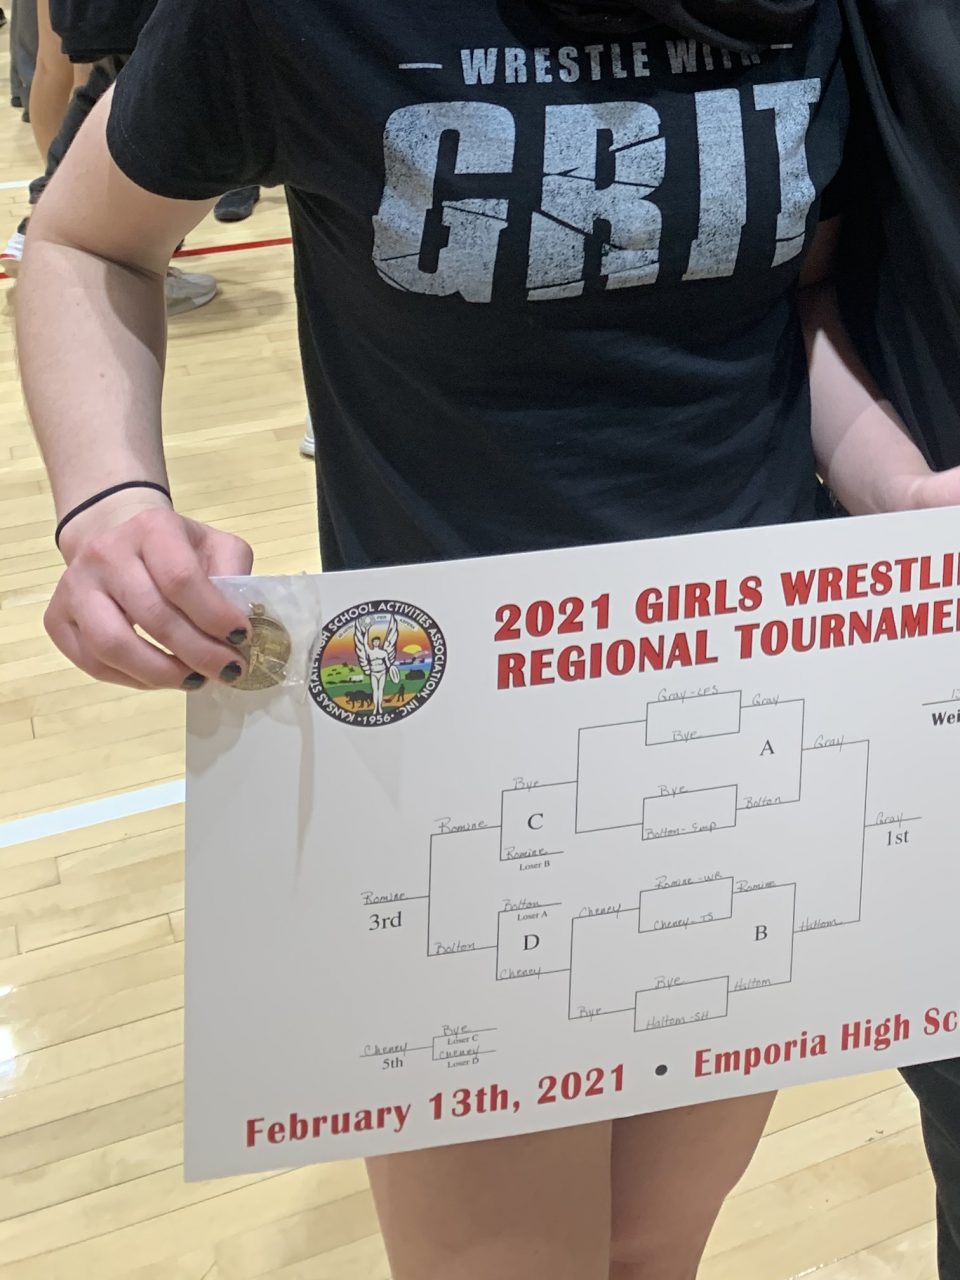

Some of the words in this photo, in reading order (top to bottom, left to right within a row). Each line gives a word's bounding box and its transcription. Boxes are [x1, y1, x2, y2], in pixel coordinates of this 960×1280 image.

[460, 40, 651, 85] WRESTLE
[372, 77, 822, 303] GRIT
[328, 603, 375, 632] SCHOOL
[378, 602, 433, 628] ACTIVITIES
[494, 593, 609, 642] 2021
[635, 575, 762, 625] GIRLS
[497, 629, 718, 690] REGIONAL
[316, 693, 356, 723] KANSAS
[363, 713, 391, 725] 1956
[759, 740, 775, 756] A
[527, 813, 543, 830] C
[887, 830, 909, 846] 1st
[520, 861, 541, 871] Loser
[544, 860, 550, 868] B
[369, 911, 402, 931] 3rd
[517, 913, 538, 921] Loser
[523, 934, 540, 951] D
[754, 925, 768, 942] B
[382, 1057, 404, 1070] 5th
[245, 1097, 413, 1149] February
[427, 1083, 521, 1122] 13th,
[536, 1061, 626, 1107] 2021
[694, 1031, 828, 1081] Emporia
[840, 1016, 911, 1061] High
